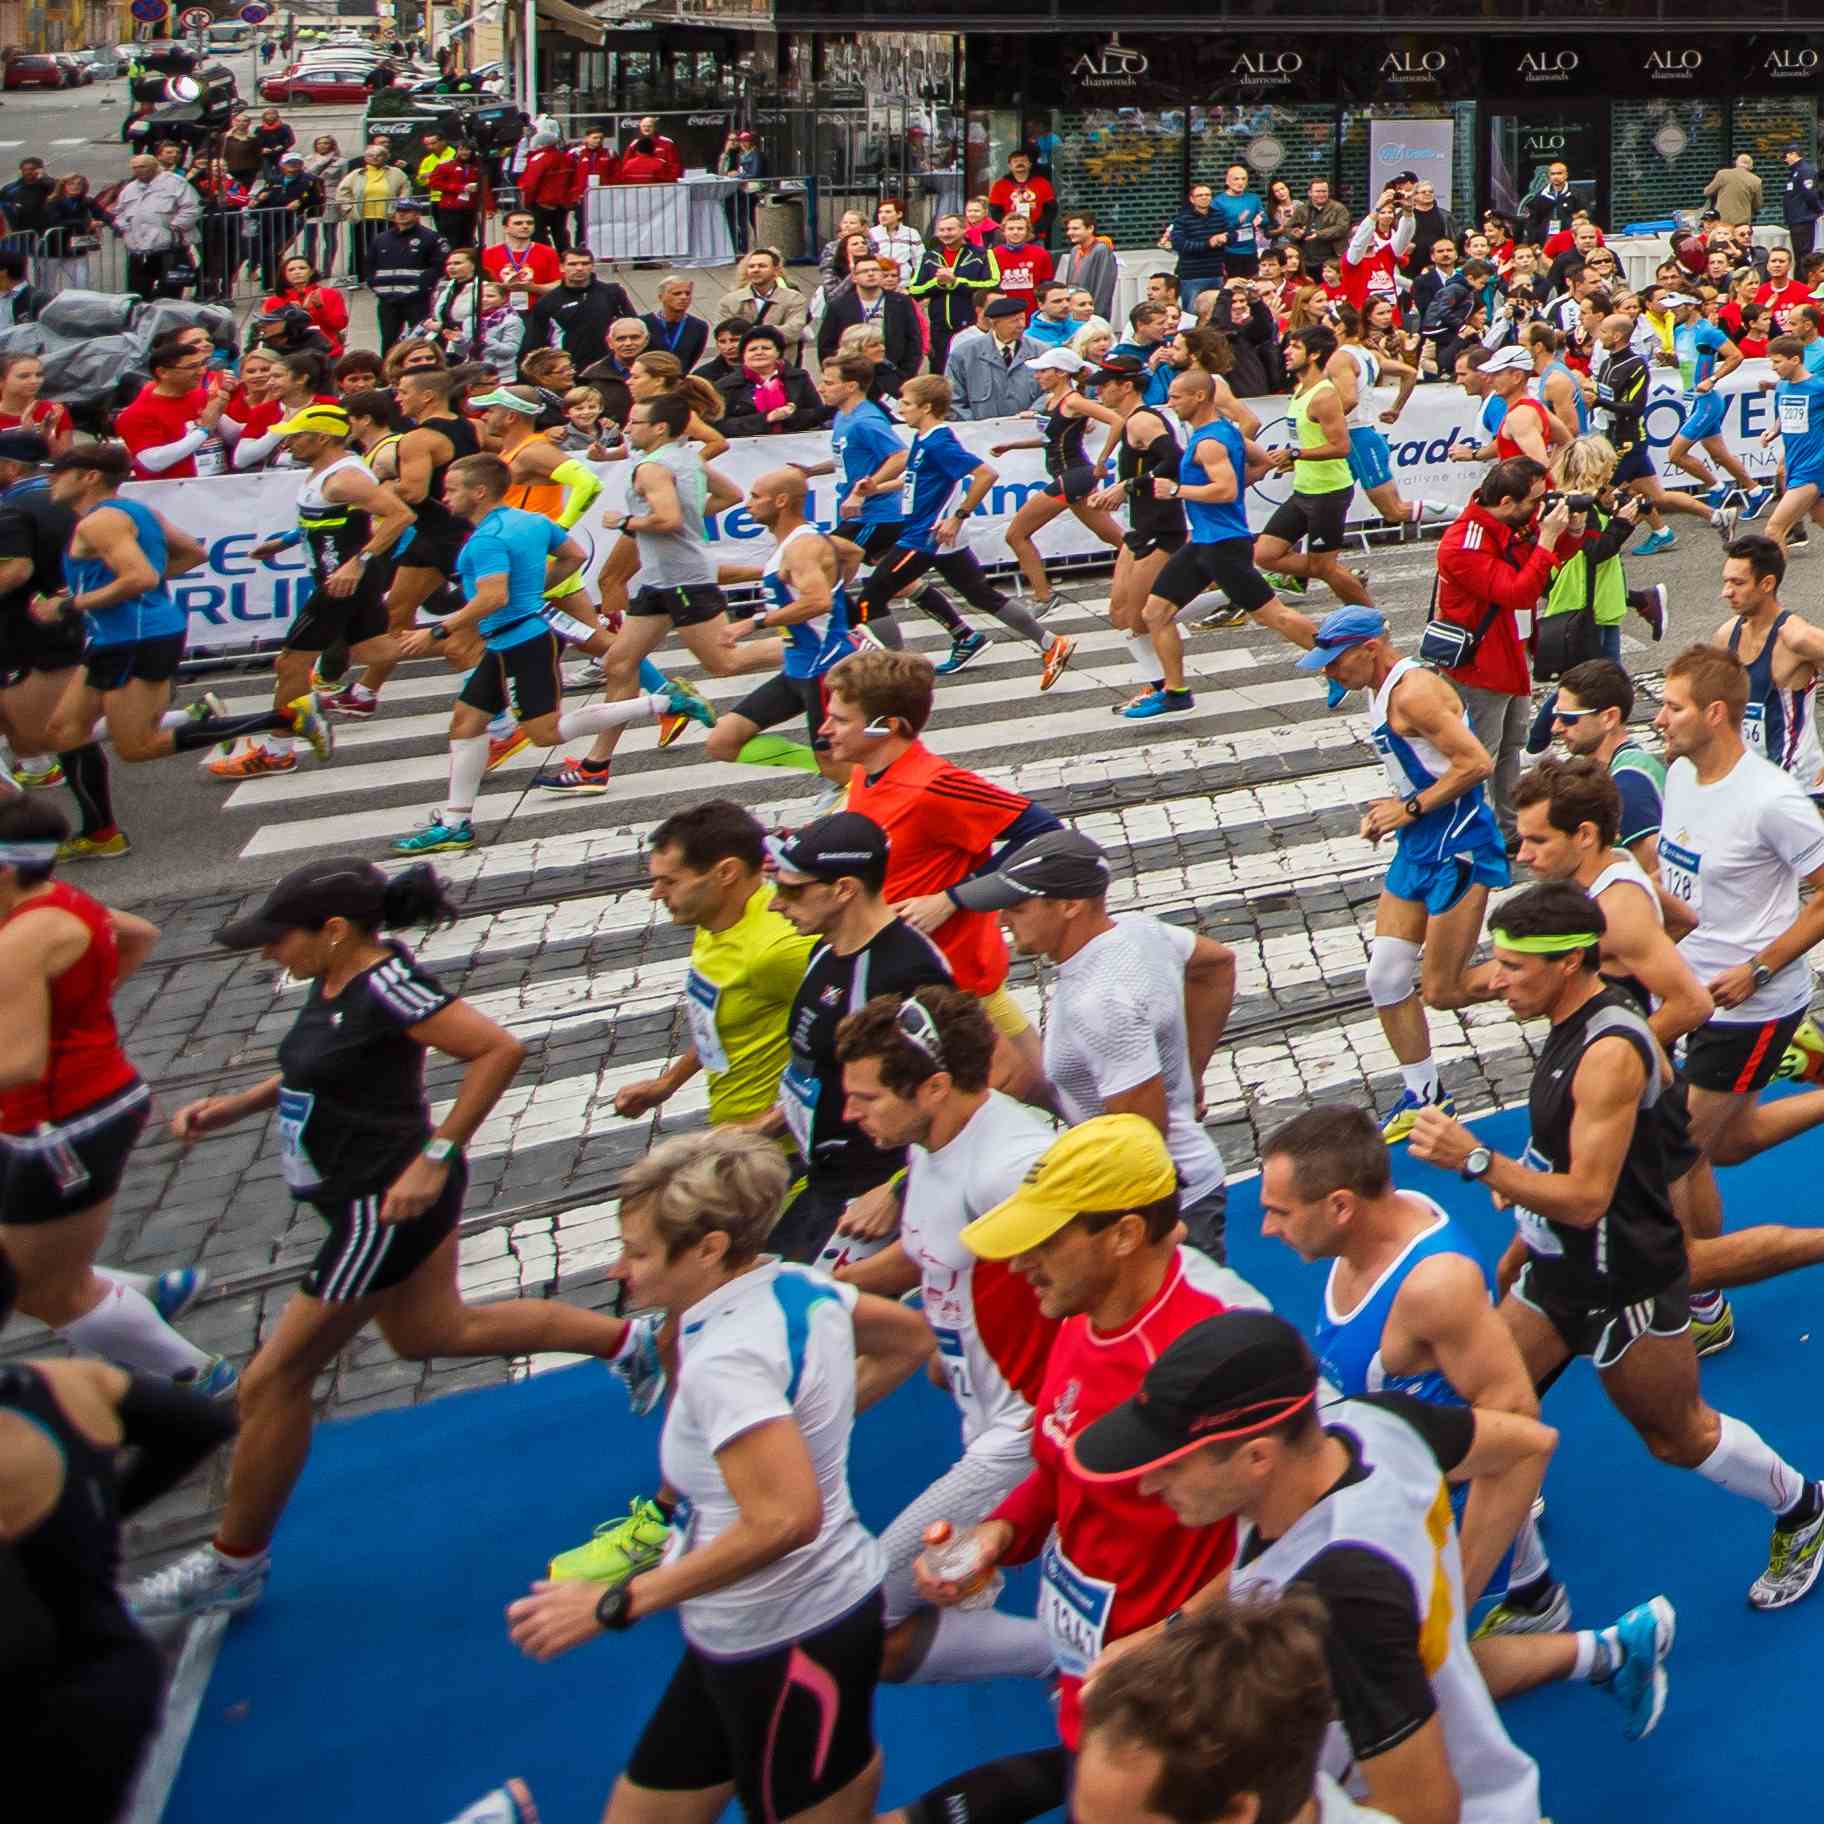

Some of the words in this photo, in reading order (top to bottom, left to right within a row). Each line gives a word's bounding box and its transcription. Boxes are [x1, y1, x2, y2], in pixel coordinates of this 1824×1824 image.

[1071, 53, 1149, 75] ALO
[1230, 52, 1303, 74] ALO
[1379, 51, 1447, 72] ALO
[1517, 51, 1578, 72] ALO
[1644, 49, 1703, 70] ALO
[1764, 49, 1819, 69] ALO
[1081, 77, 1137, 88] diamonds
[1239, 74, 1292, 86] diamonds
[1523, 134, 1566, 150] ALO
